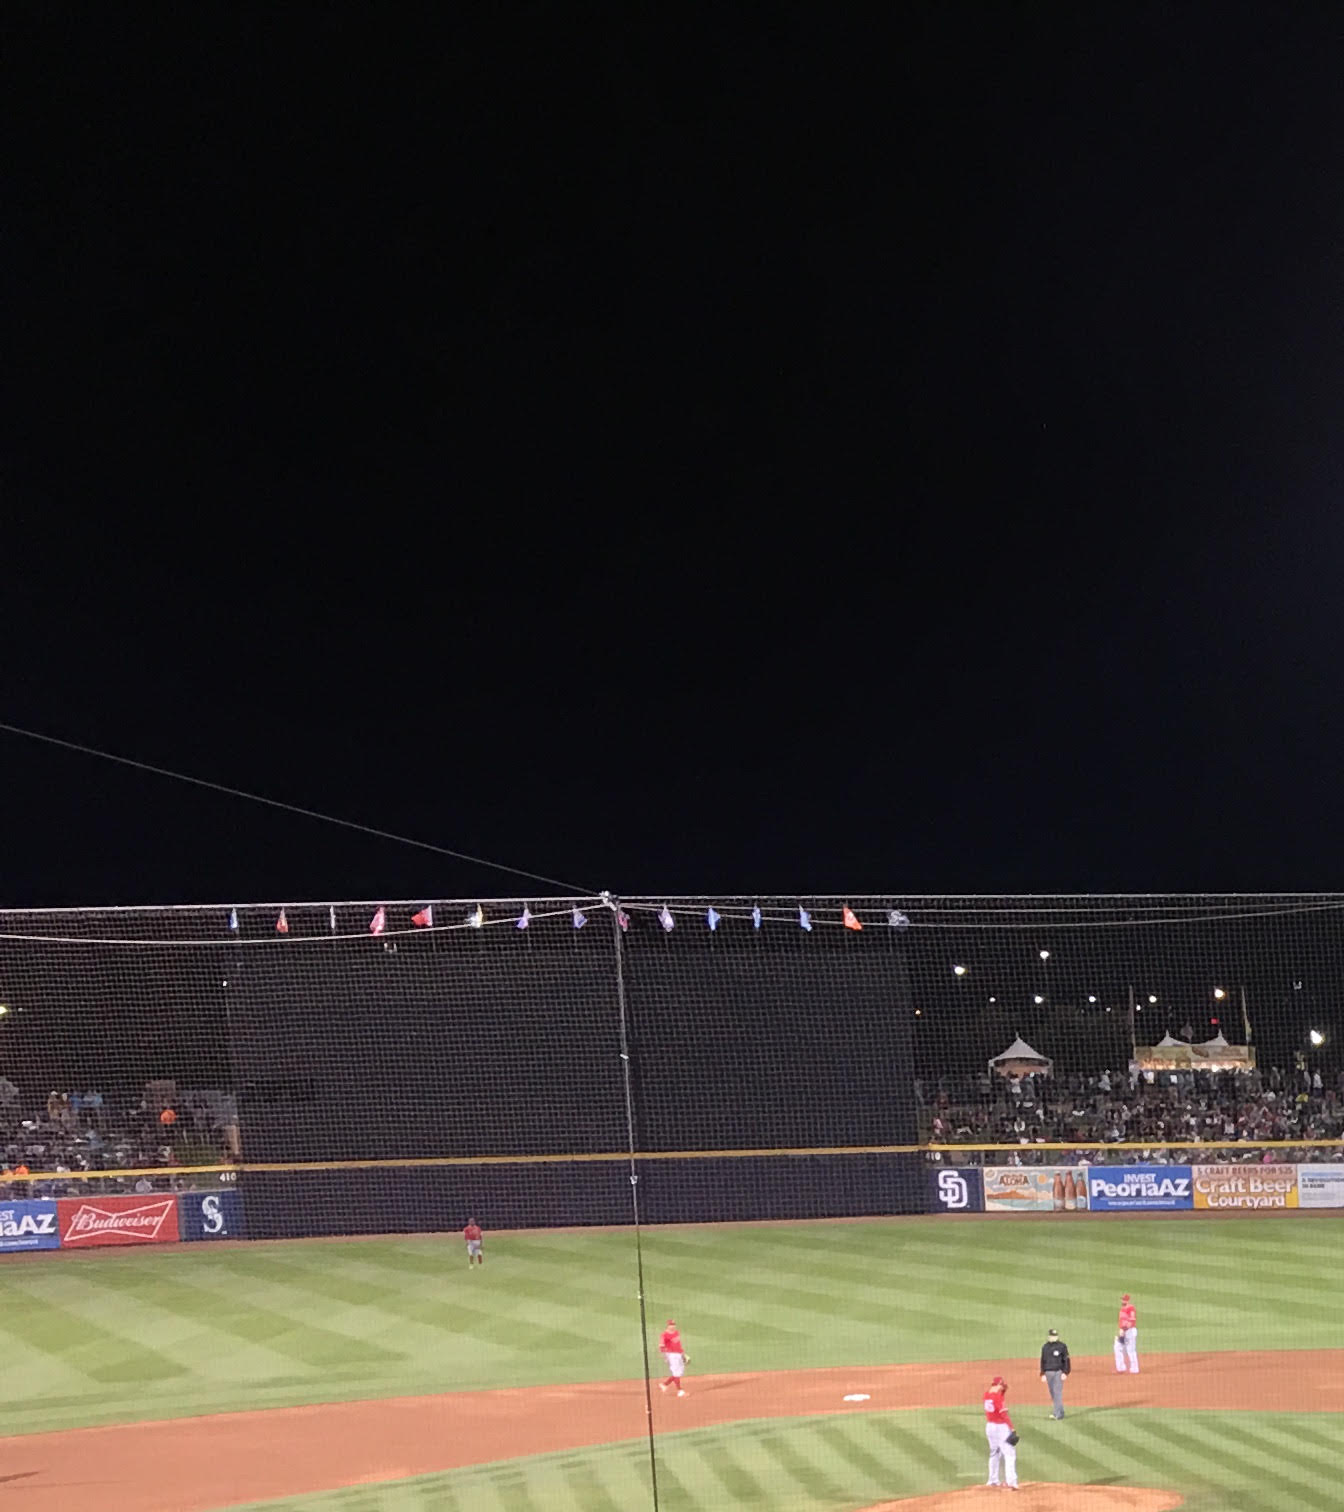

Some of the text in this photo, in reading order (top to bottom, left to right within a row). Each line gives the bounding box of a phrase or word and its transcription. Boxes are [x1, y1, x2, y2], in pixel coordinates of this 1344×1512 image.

[1123, 1173, 1156, 1183] INVEST
[1204, 1167, 1230, 1175] CRAFT
[1260, 1167, 1277, 1175] FOR
[938, 1170, 968, 1208] SD
[1091, 1178, 1191, 1197] PeoriaAZ
[1195, 1176, 1296, 1193] Craft Beer
[1207, 1193, 1285, 1209] Courtyard
[72, 1212, 162, 1231] Budweiser
